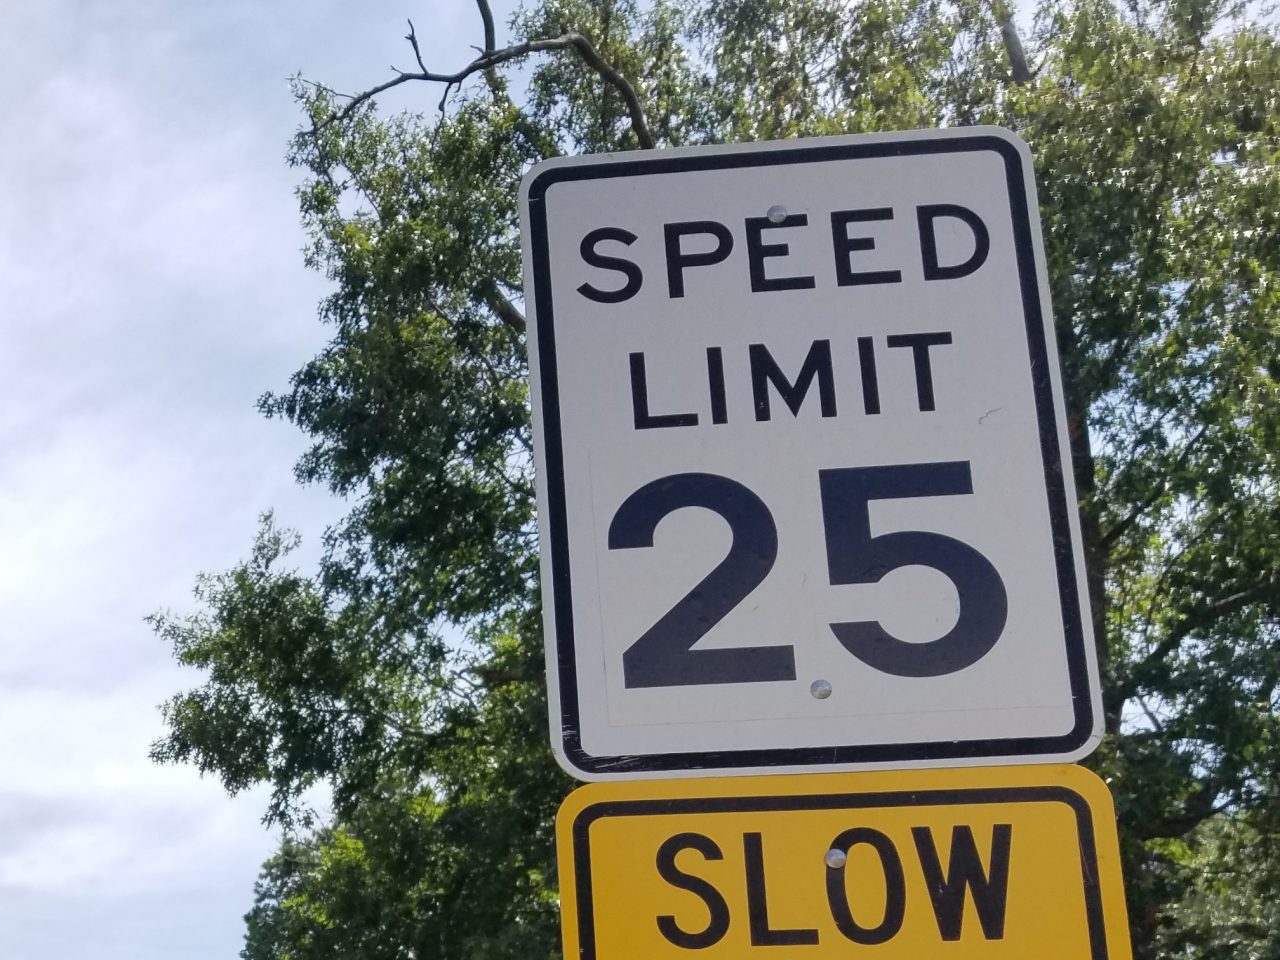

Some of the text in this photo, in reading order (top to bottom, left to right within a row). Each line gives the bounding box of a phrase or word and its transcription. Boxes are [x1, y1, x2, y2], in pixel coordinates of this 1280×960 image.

[576, 203, 990, 304] SPEED
[628, 331, 953, 430] LIMIT
[607, 460, 1008, 689] 25
[655, 823, 1012, 950] SLOW
